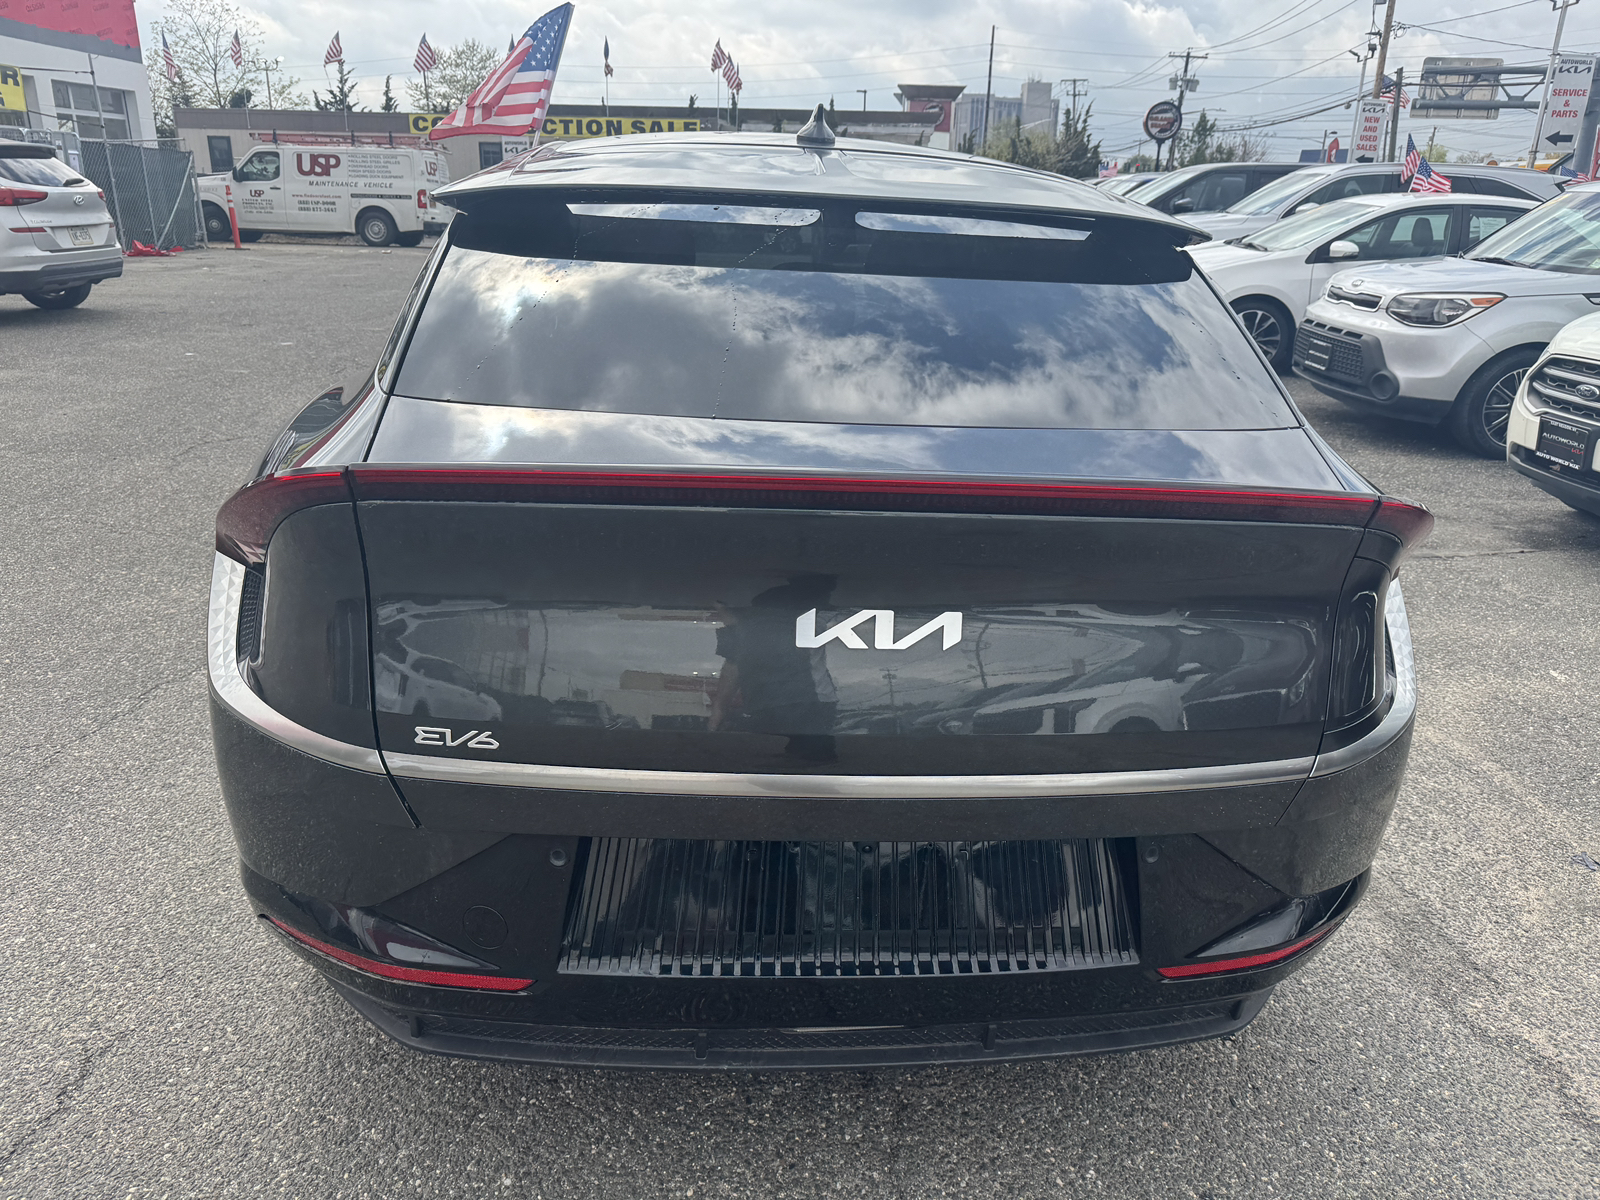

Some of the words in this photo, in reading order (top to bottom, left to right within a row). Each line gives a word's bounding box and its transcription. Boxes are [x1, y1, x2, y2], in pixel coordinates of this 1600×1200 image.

[1560, 58, 1593, 66] AUTOWORLD
[1558, 65, 1592, 74] KIA
[1552, 88, 1588, 97] SERVICE
[1563, 99, 1570, 107] &
[1551, 109, 1578, 118] PARTS
[1356, 144, 1377, 152] SALES
[296, 153, 341, 176] USP
[425, 160, 438, 176] USP
[308, 180, 359, 188] MAINTENANCE
[249, 189, 264, 198] USP
[1542, 432, 1585, 449] AUTOWORLD
[1535, 451, 1550, 460] AUTO
[1550, 455, 1569, 466] WORLD
[1569, 461, 1581, 470] KIA
[795, 607, 963, 651] KIA
[414, 726, 500, 750] EV6
